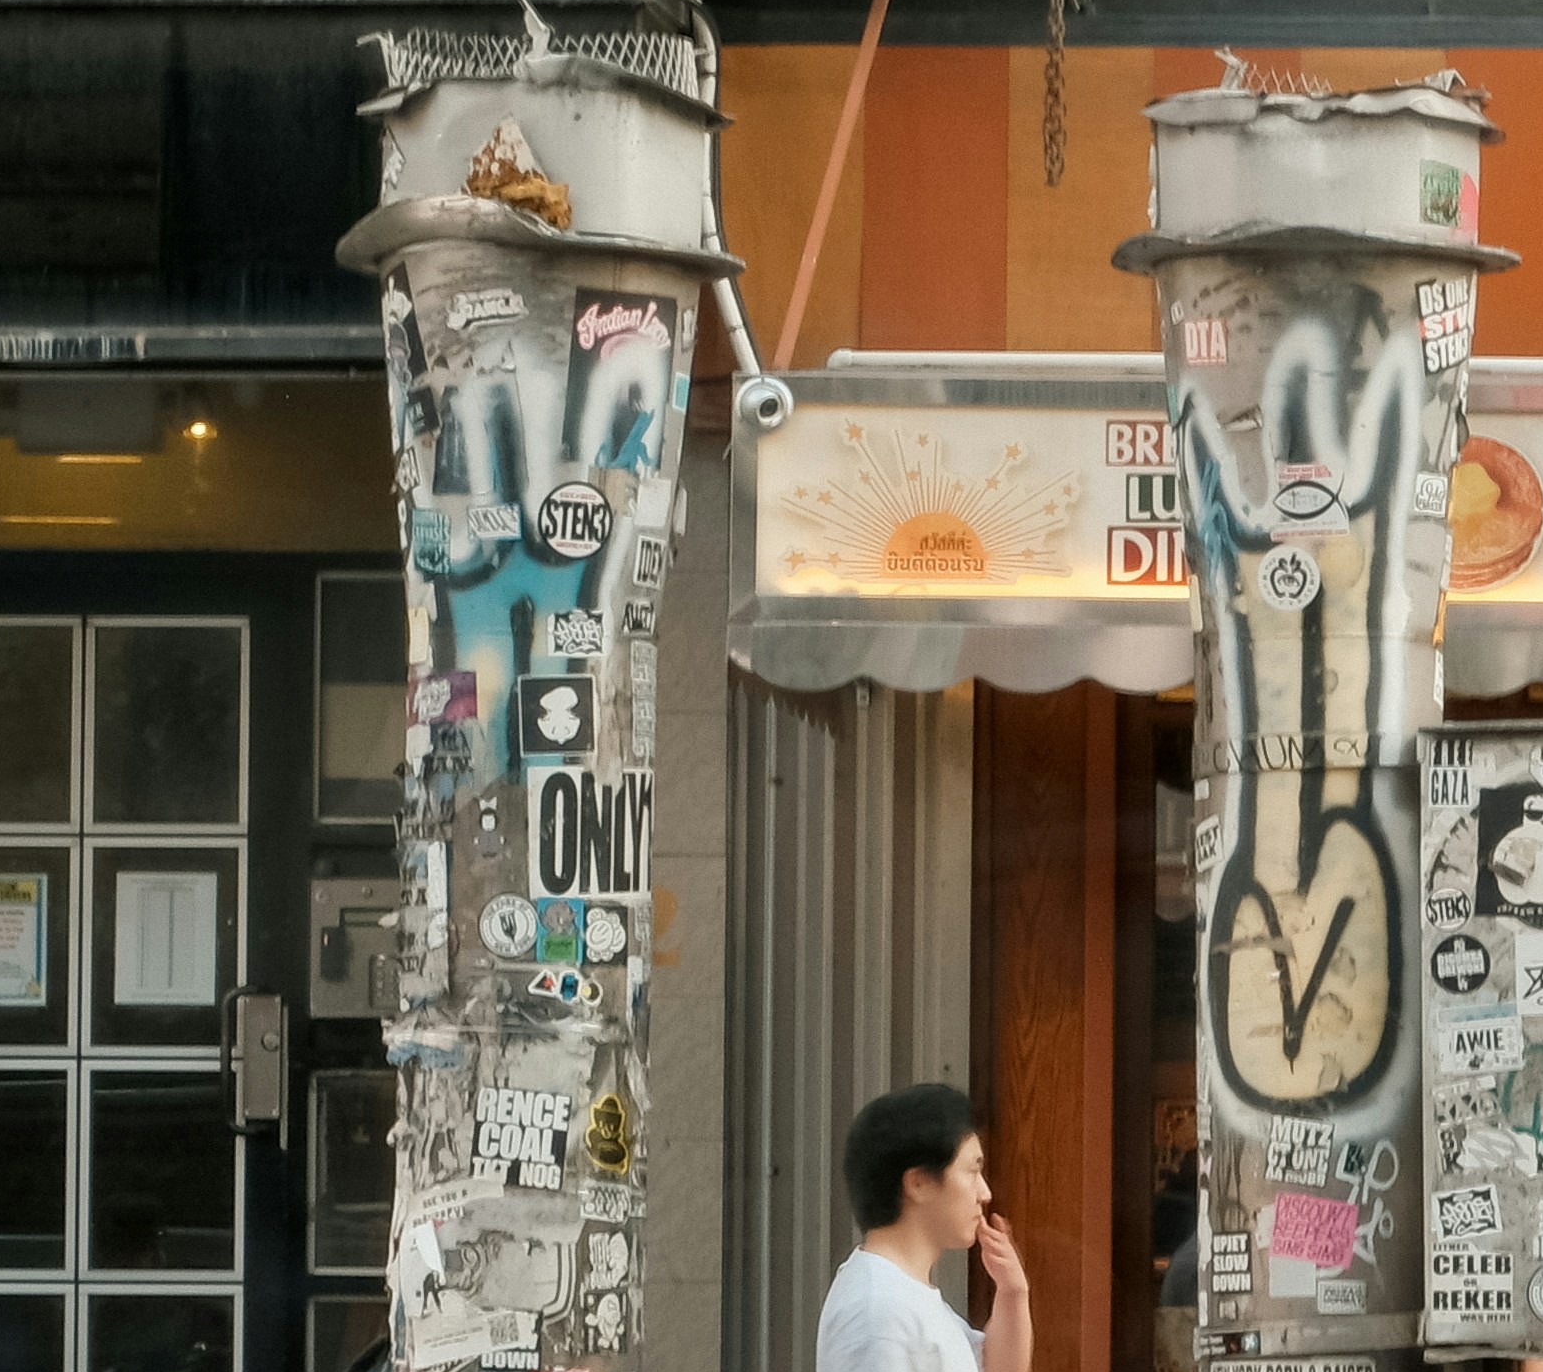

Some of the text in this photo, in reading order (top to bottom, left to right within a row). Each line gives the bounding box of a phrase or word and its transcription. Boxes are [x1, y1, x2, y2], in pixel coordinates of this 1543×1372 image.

[1431, 769, 1470, 806] GAZA
[540, 771, 653, 895] ONLY
[477, 1088, 570, 1131] RENCE
[478, 1122, 555, 1164] COAL
[1433, 1254, 1511, 1275] CELEB
[1213, 1274, 1250, 1291] DOWN
[1433, 1290, 1512, 1310] REKER
[481, 1351, 540, 1370] DOWN
